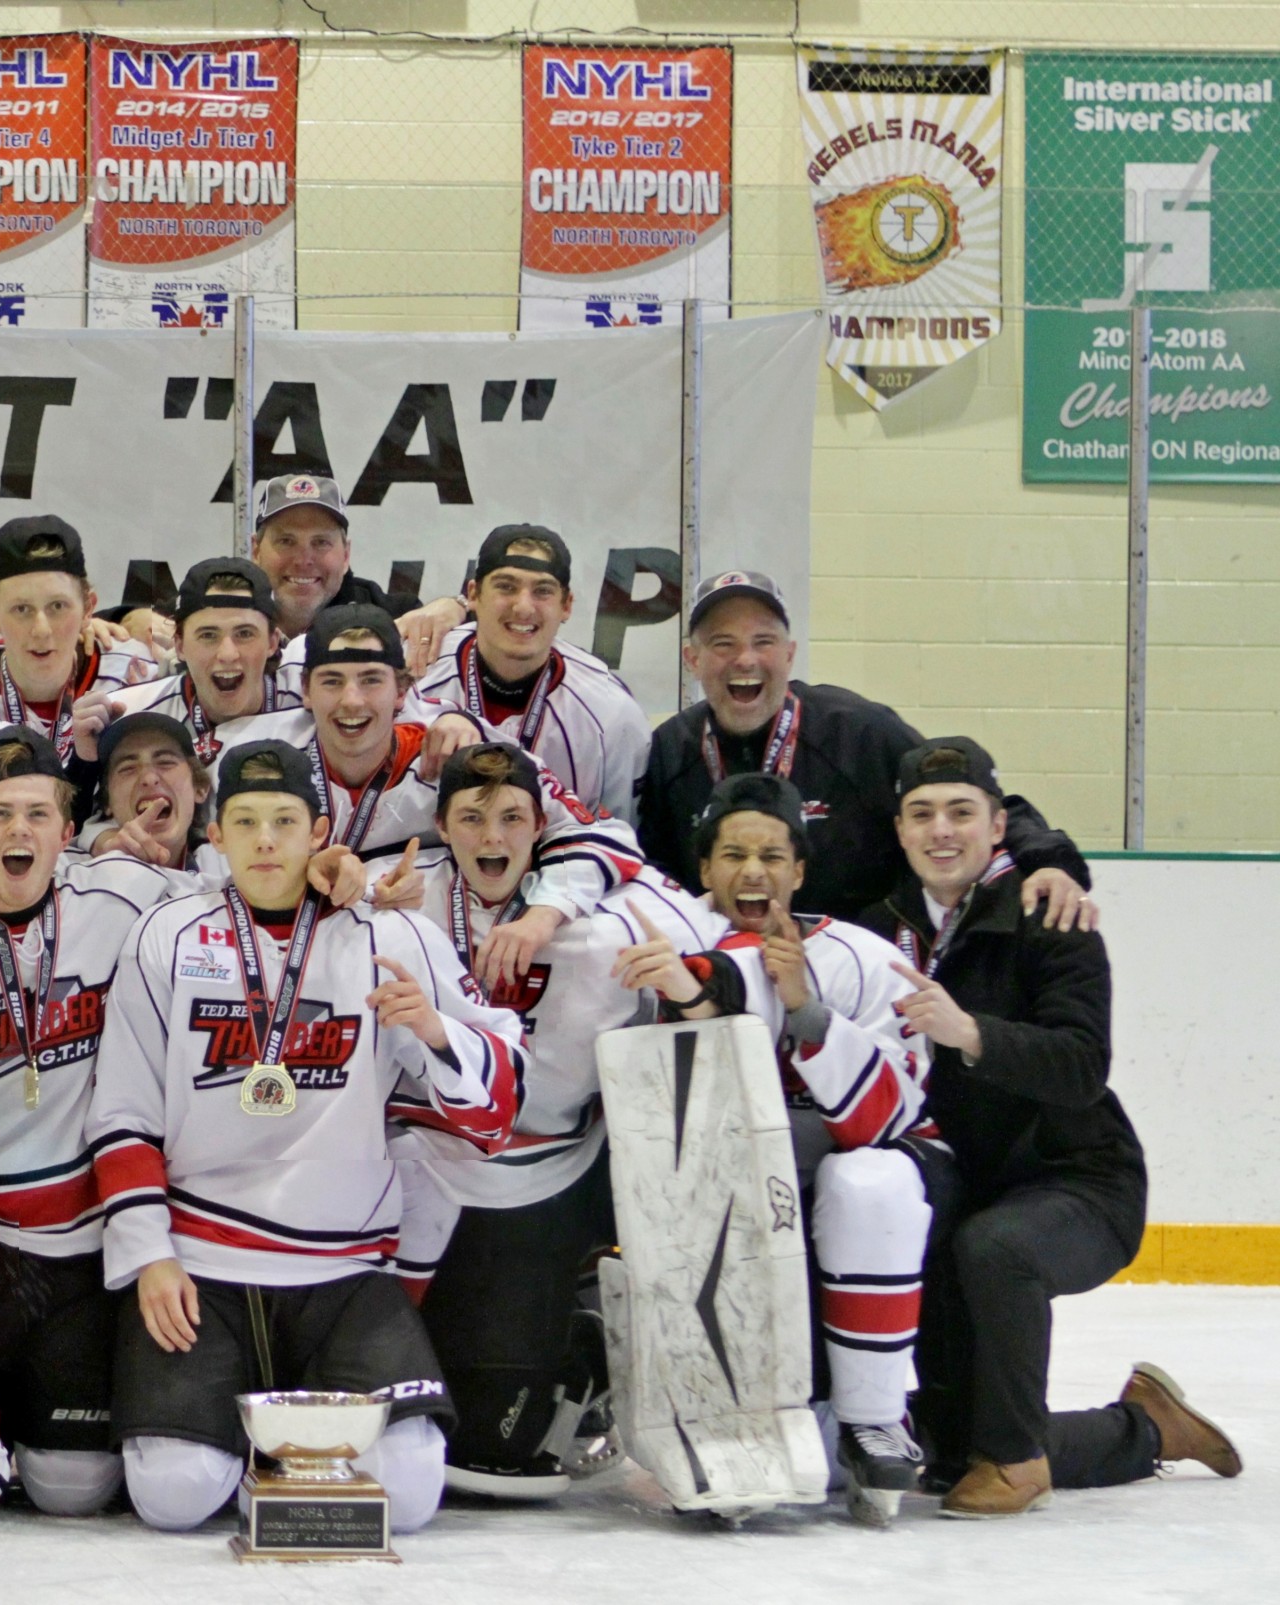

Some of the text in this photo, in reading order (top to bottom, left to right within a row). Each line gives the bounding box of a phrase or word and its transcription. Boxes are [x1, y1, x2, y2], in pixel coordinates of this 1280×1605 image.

[109, 50, 278, 91] NYHL
[542, 58, 711, 101] NYHL
[1064, 77, 1272, 103] International
[116, 100, 270, 118] 2014/2015
[549, 110, 702, 128] 2016/2017
[1074, 108, 1250, 132] Silver Stick
[39, 129, 51, 148] 4
[112, 125, 274, 150] Midget Jr Tier 1
[571, 136, 683, 159] Tyke Tier 2
[808, 118, 996, 190] REBELS MANIA
[96, 158, 286, 205] CHAMPION
[529, 168, 720, 215] CHAMPION
[119, 219, 262, 236] NORTH TORONTO
[552, 228, 697, 246] NORTH TORONTO
[830, 316, 989, 340] HAMPIONS
[1079, 351, 1245, 370] Mino Atom AA
[877, 374, 912, 387] 2017
[1152, 439, 1186, 460] ON
[1194, 441, 1280, 464] Regiona
[180, 965, 231, 980] MILK
[9, 991, 24, 1028] 2018
[199, 1004, 227, 1017] TED
[265, 1030, 282, 1064] 2018
[287, 1507, 354, 1519] NOHA CUP
